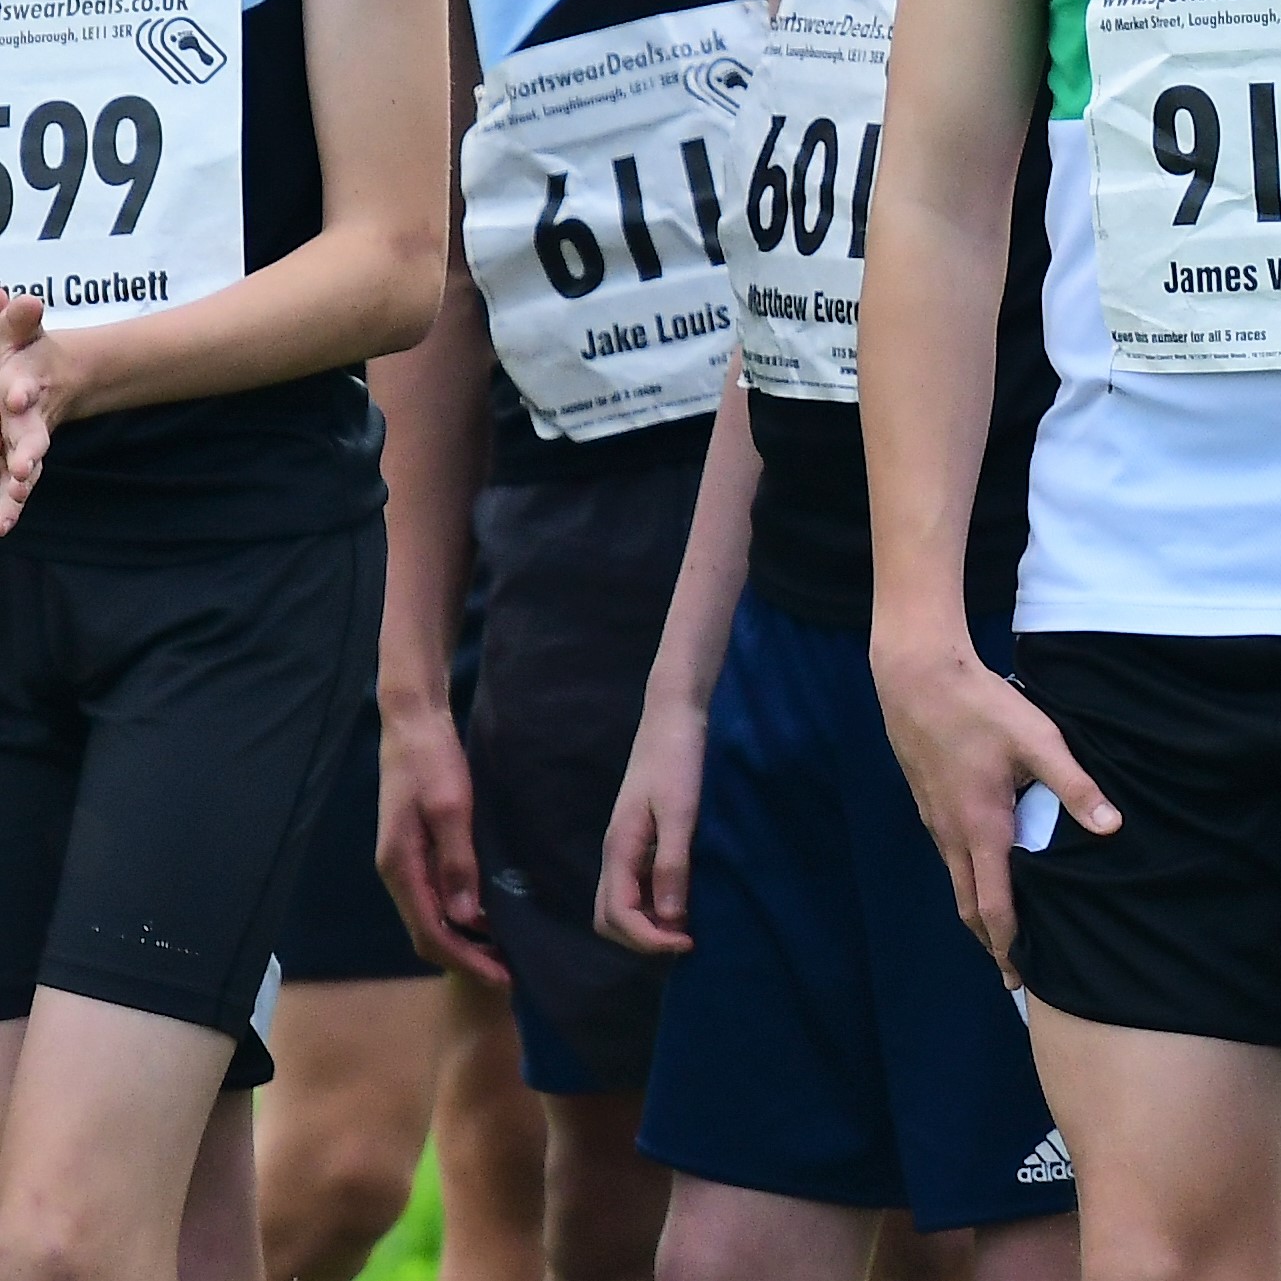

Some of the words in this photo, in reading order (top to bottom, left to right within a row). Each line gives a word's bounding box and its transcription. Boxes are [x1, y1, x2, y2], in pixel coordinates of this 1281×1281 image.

[112, 24, 133, 38] 3ER
[1115, 16, 1148, 31] Market
[1151, 15, 1184, 30] Street,
[1188, 9, 1280, 28] Loughborough,
[0, 95, 162, 241] 99
[747, 115, 884, 259] 601
[534, 138, 727, 299] 611
[65, 271, 168, 306] Corbett
[1164, 261, 1258, 293] James
[581, 322, 648, 360] Jake
[654, 302, 731, 344] Louis
[1151, 331, 1188, 343] number
[1208, 330, 1221, 342] all
[1225, 330, 1232, 341] 5
[1235, 330, 1267, 341] races
